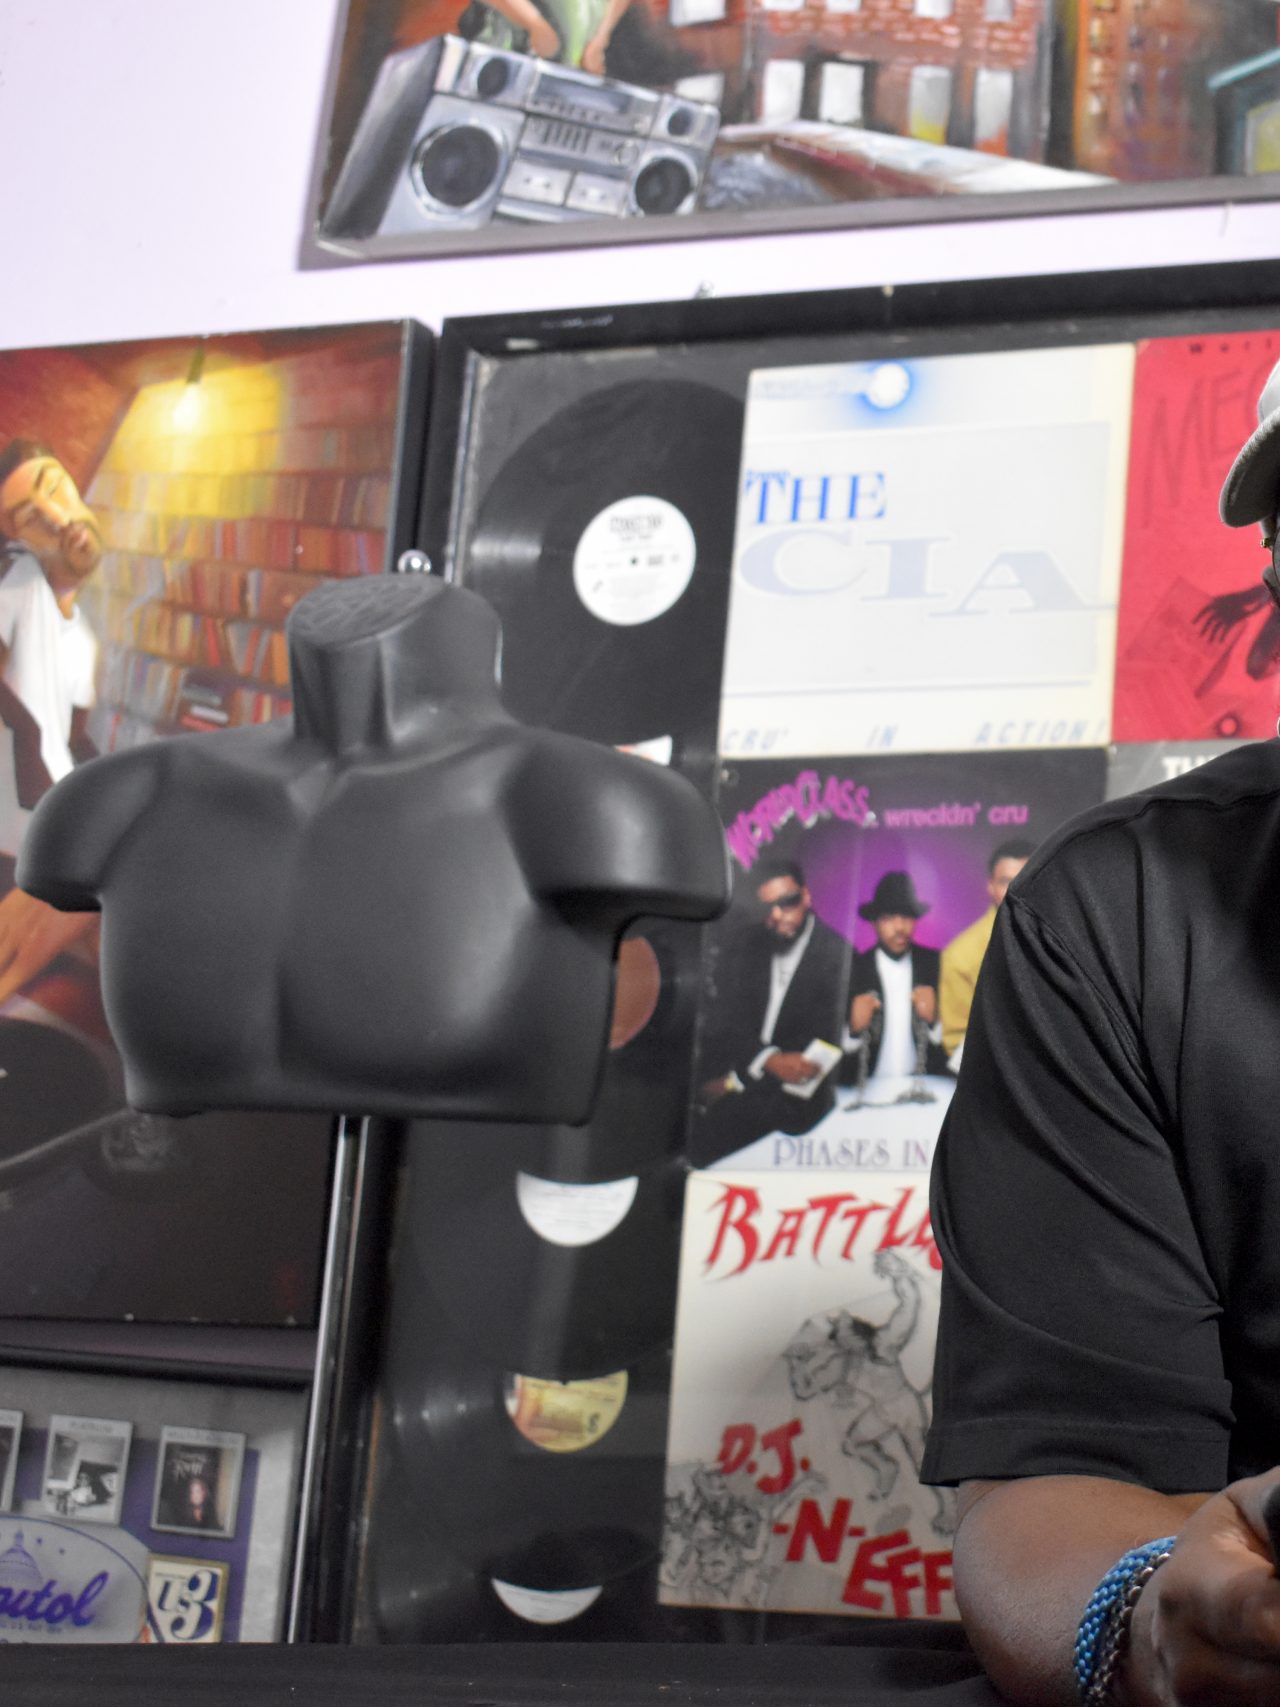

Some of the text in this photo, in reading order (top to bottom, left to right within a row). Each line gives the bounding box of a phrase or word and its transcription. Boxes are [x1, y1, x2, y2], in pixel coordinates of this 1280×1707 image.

[745, 468, 887, 525] THE
[740, 528, 1115, 619] CIA
[865, 722, 901, 749] IN
[974, 718, 1107, 747] ACTION!
[988, 803, 1029, 826] cru
[772, 1137, 930, 1168] PHASES IN
[717, 1418, 811, 1495] D.J.
